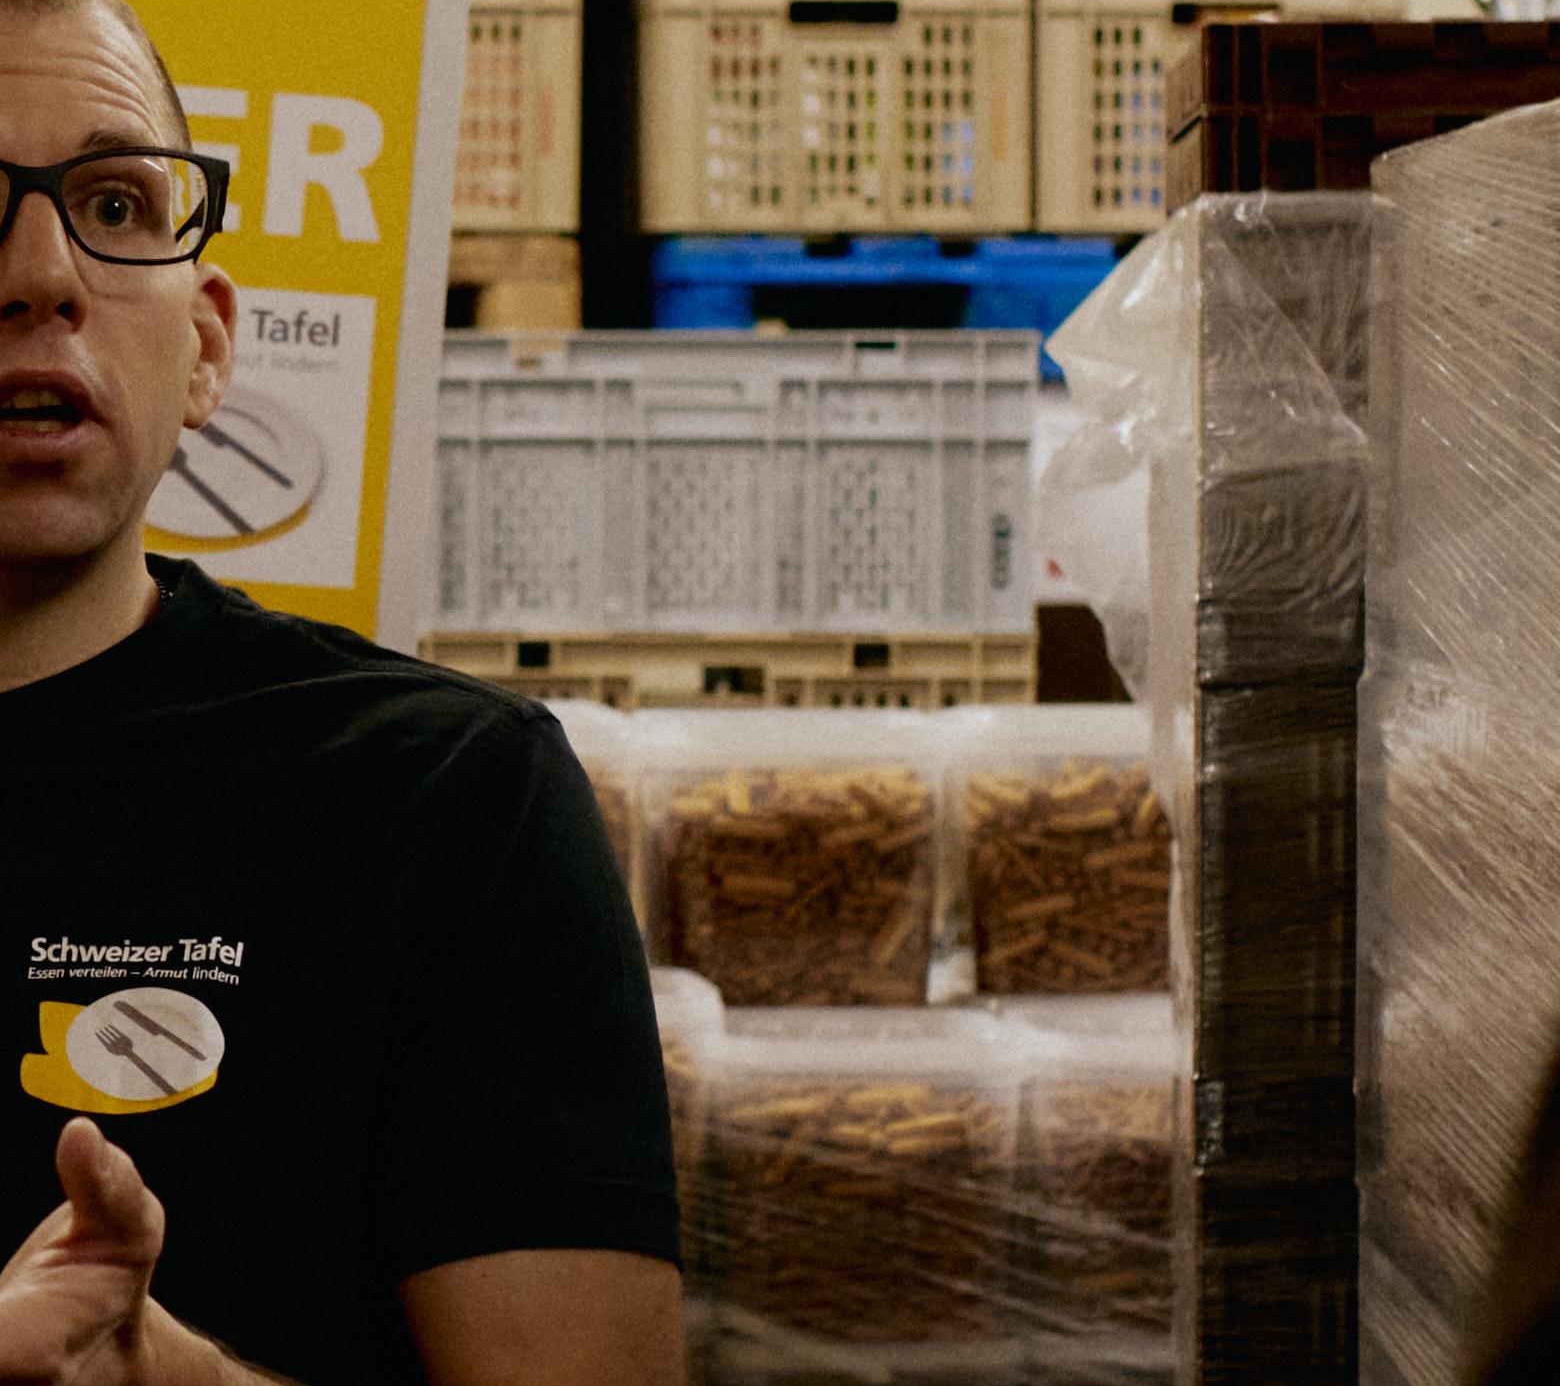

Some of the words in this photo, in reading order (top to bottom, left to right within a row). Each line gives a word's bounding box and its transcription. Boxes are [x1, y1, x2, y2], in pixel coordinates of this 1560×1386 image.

[249, 309, 339, 346] Tafel
[30, 936, 173, 964] Schweizer
[179, 936, 244, 967] Tafel
[28, 966, 65, 980] Essen
[69, 966, 127, 979] verteilen
[142, 966, 189, 980] Armut
[192, 966, 239, 986] lindern
